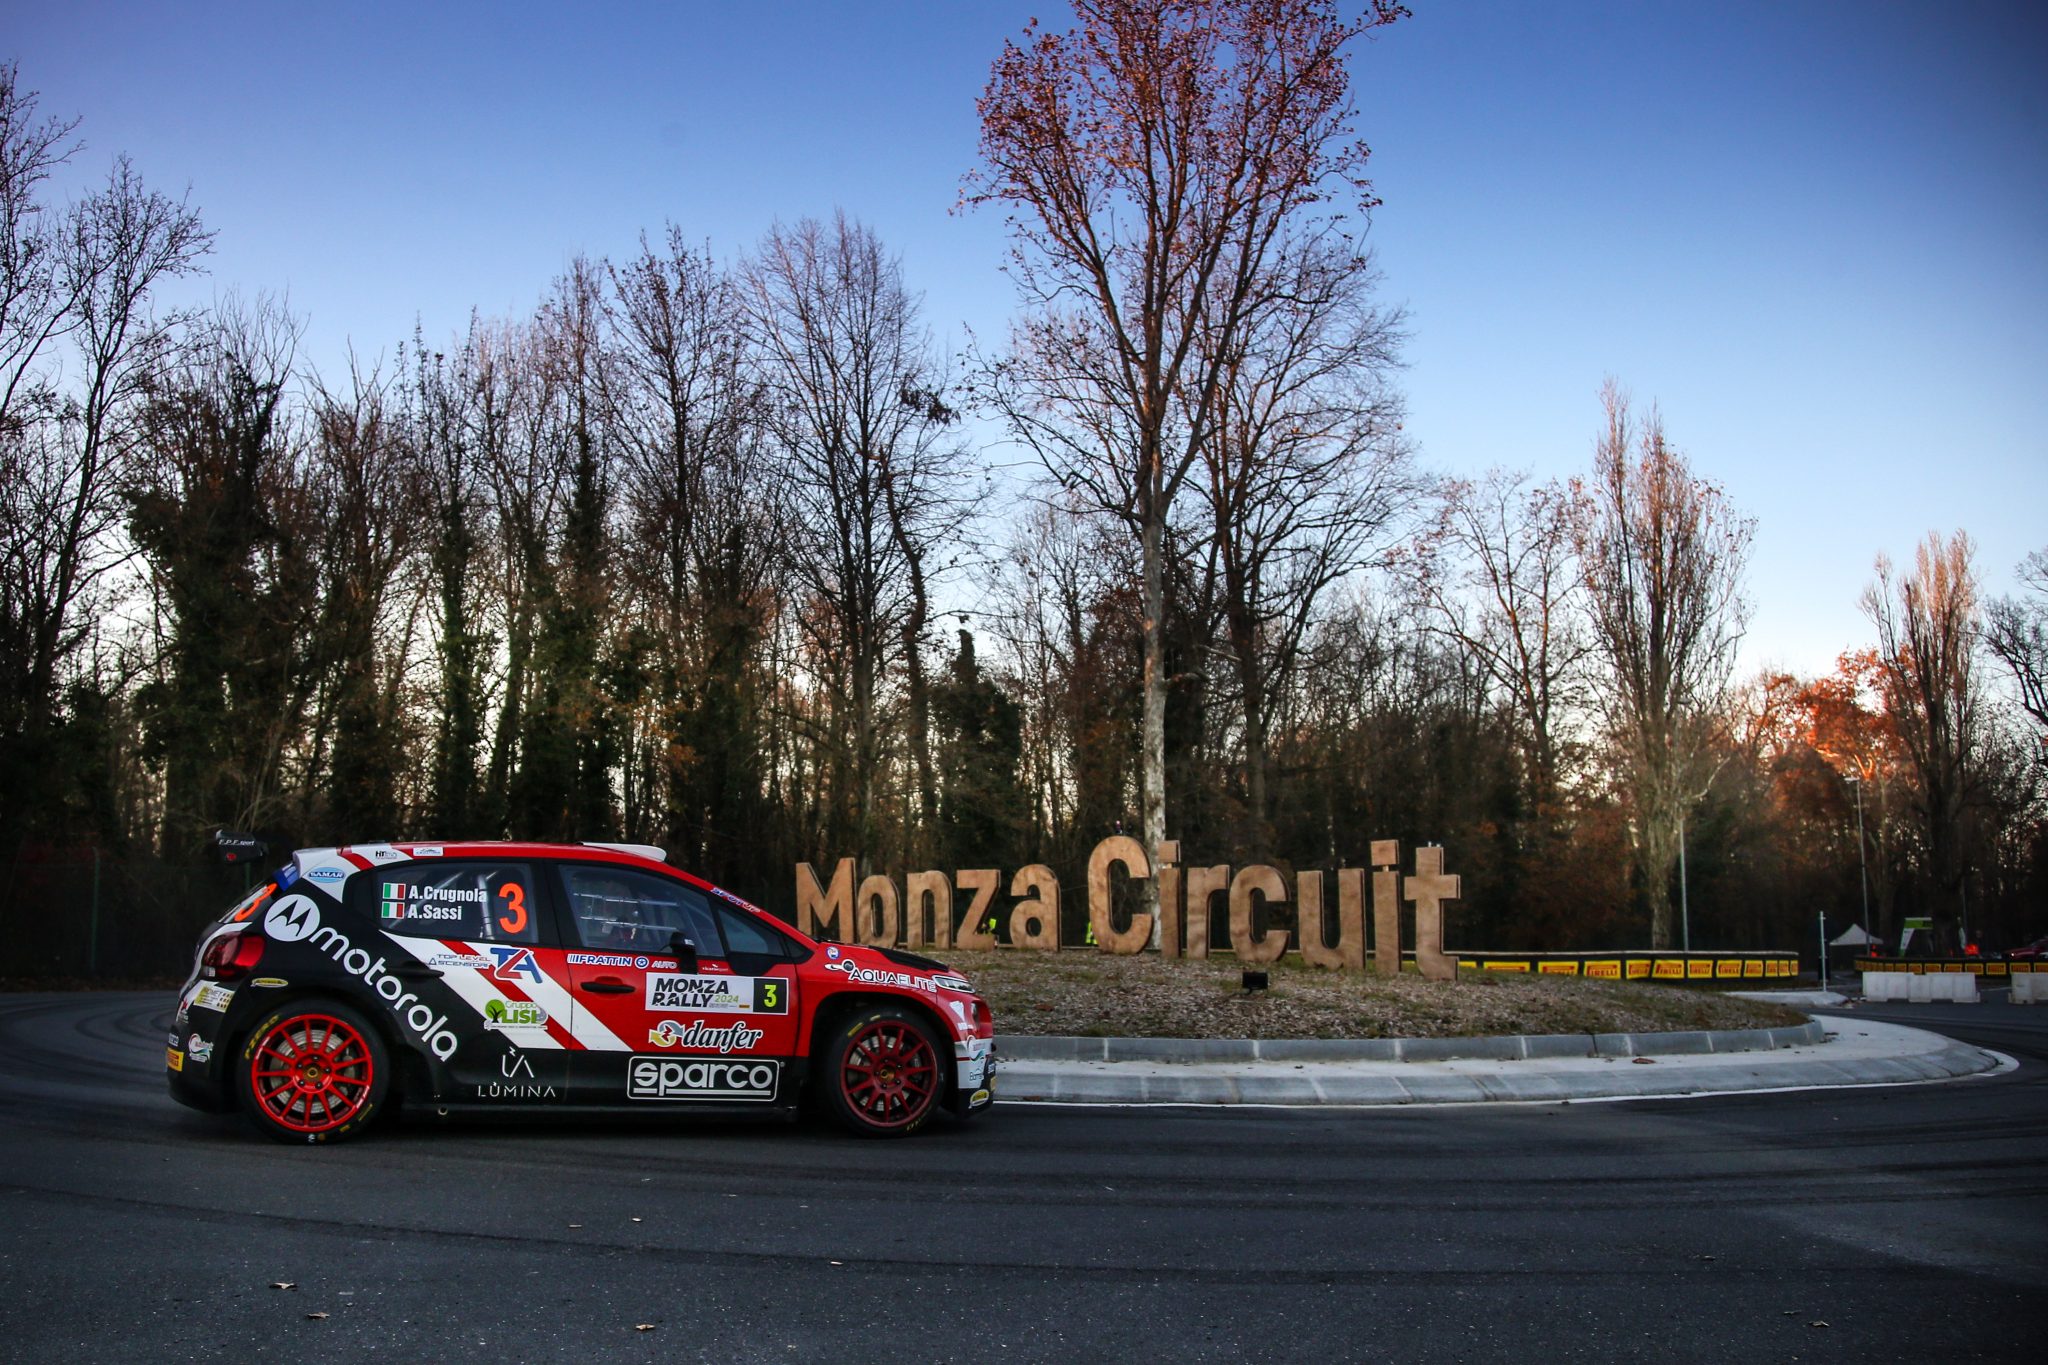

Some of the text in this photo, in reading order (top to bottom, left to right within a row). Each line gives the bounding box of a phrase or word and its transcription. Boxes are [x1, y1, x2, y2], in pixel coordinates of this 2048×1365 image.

[309, 871, 345, 879] SAMAR
[408, 885, 488, 903] A.Crugnola
[407, 904, 462, 921] A.Sassi
[499, 882, 528, 935] 3
[795, 836, 1461, 981] Monza Circuit
[309, 927, 458, 1062] motorola
[655, 978, 729, 995] MONZA
[504, 1001, 539, 1009] Gruppo
[651, 992, 740, 1008] RALLY 2024
[764, 984, 777, 1008] 3
[682, 1020, 762, 1053] danfer
[633, 1061, 773, 1097] sparco
[478, 1082, 556, 1098] LUMINA
